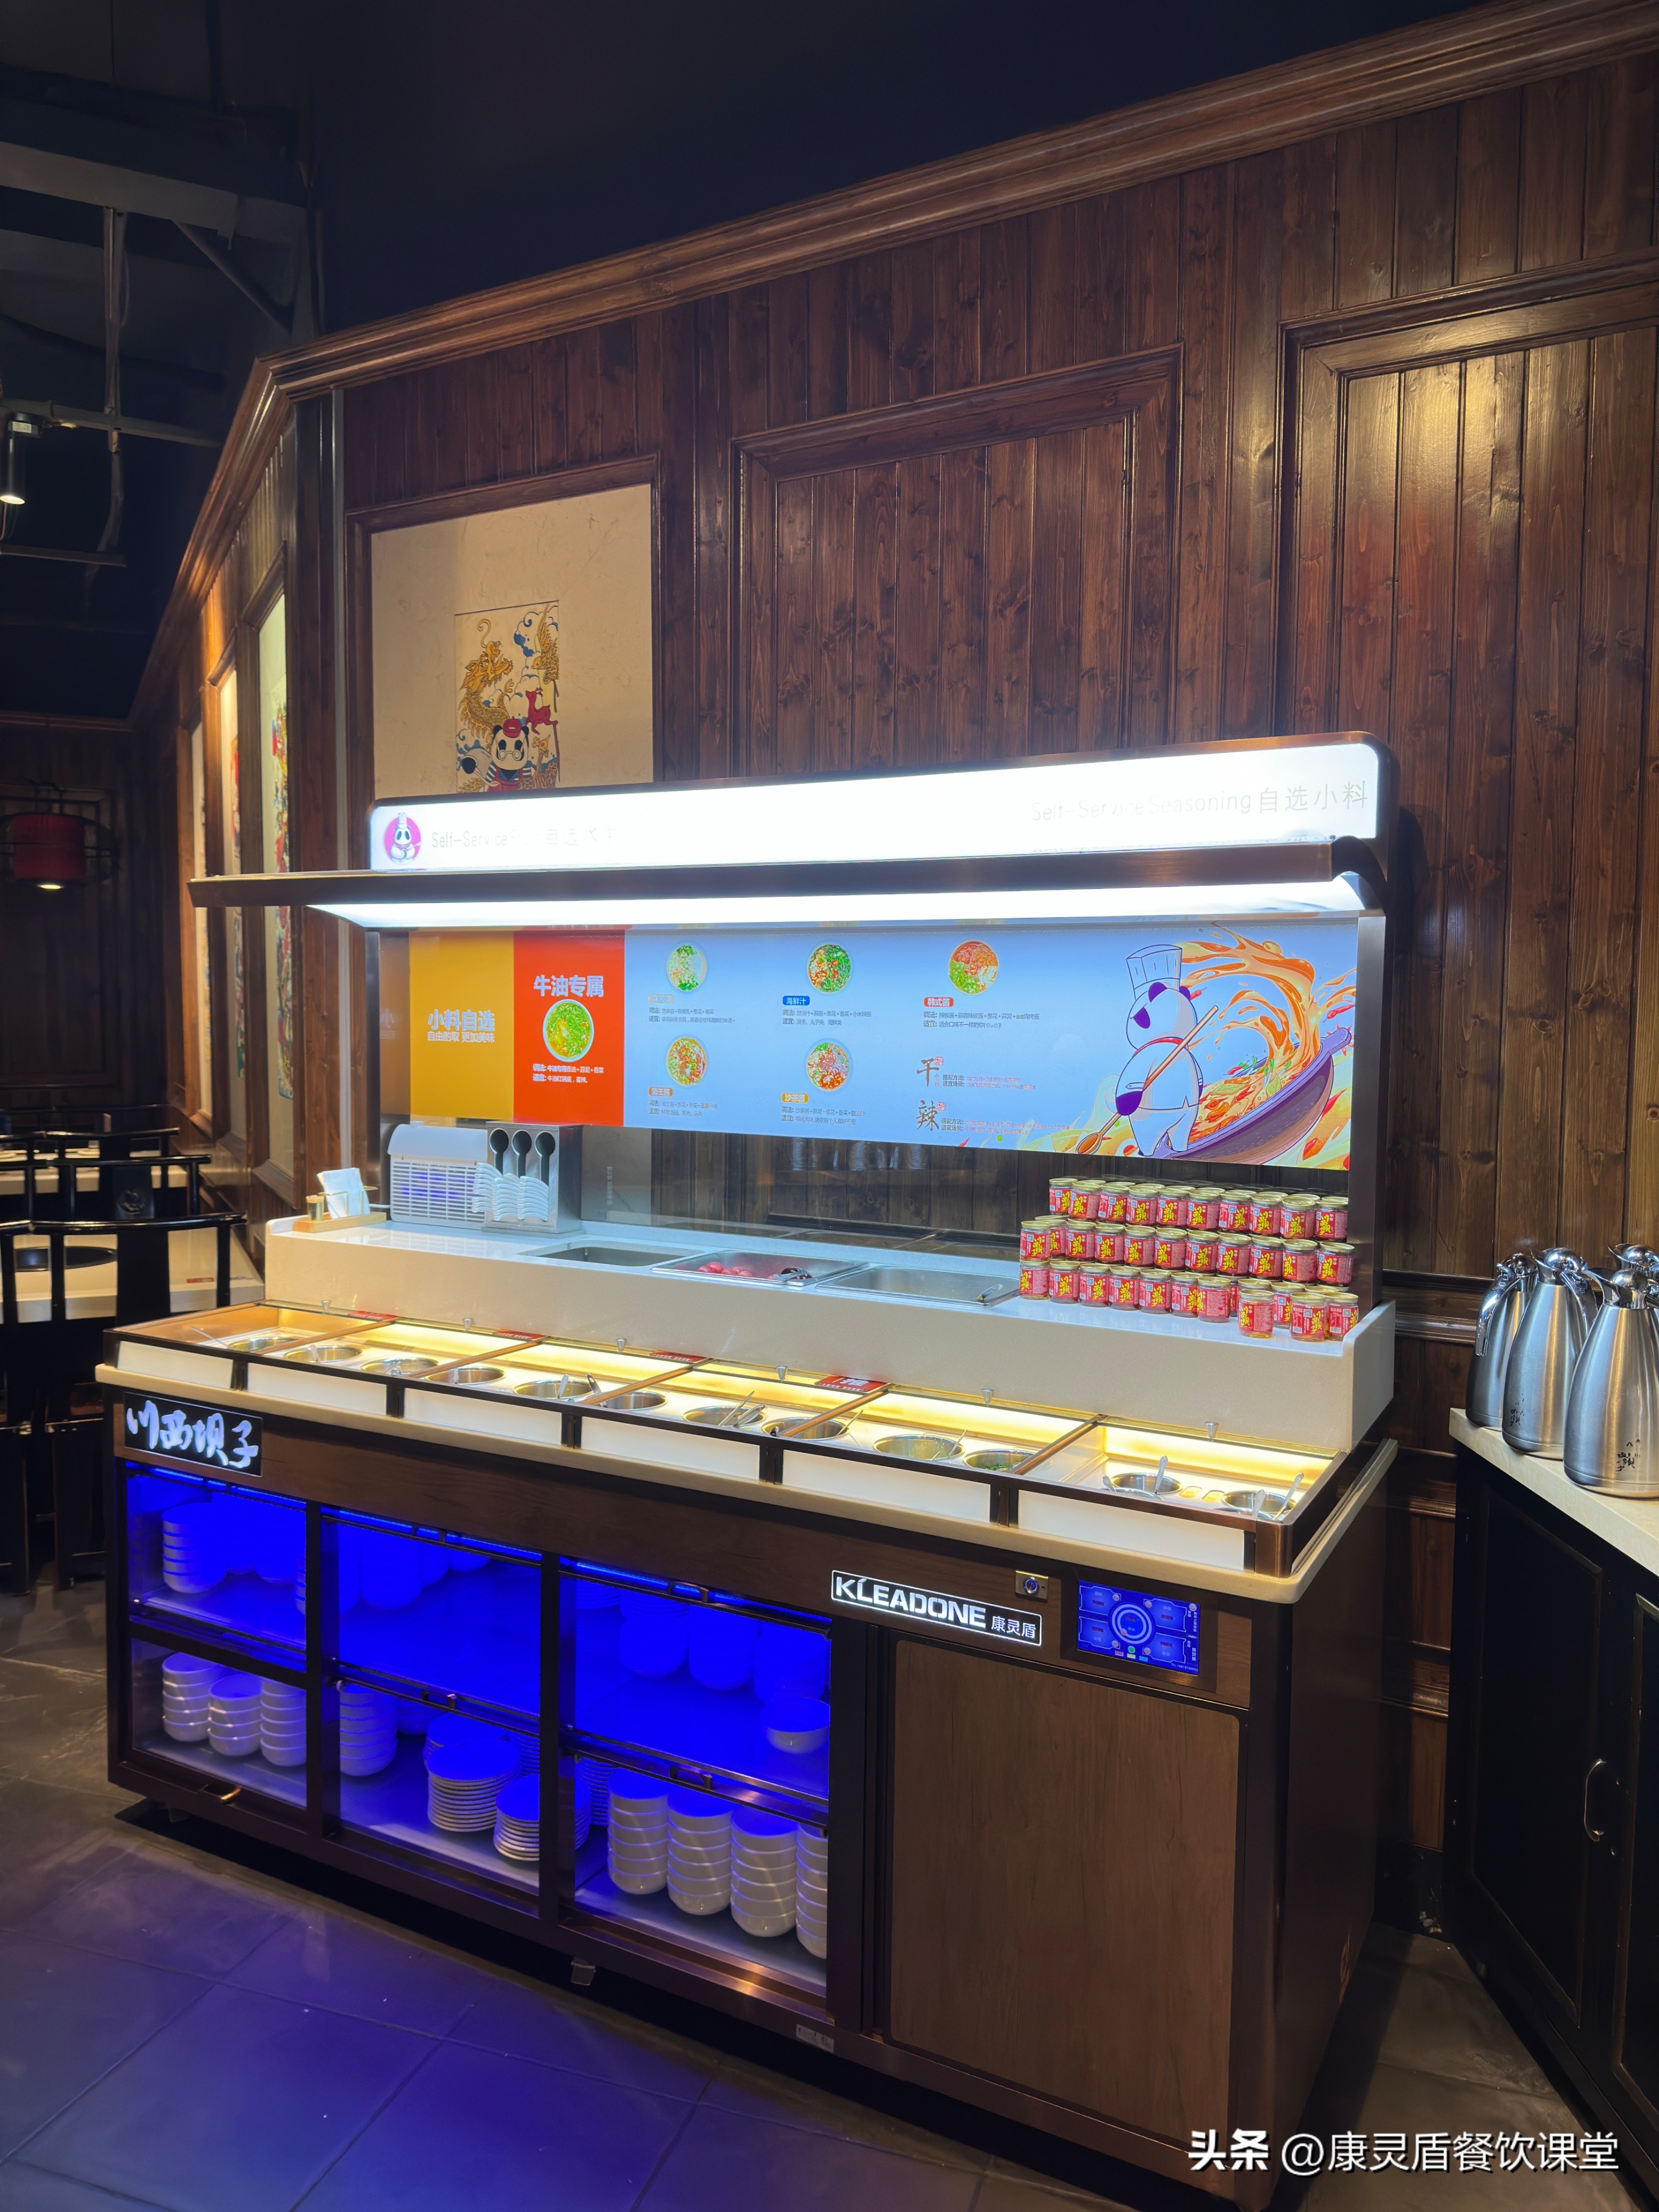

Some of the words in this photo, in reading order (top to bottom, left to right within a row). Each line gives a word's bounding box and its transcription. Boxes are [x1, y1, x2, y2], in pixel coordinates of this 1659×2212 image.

[1258, 780, 1368, 814] 自选小料
[431, 830, 507, 849] Self-Service
[534, 975, 604, 998] 牛油专属
[786, 997, 806, 1005] 海鲜汁
[927, 998, 950, 1007] 韩式酱
[427, 1008, 495, 1032] 小料自选
[461, 1031, 495, 1043] 更加美味
[915, 1099, 940, 1132] 辣
[126, 1400, 259, 1469] 川西坝子
[835, 1576, 986, 1629] KLEADONE
[990, 1615, 1037, 1639] 康灵盾
